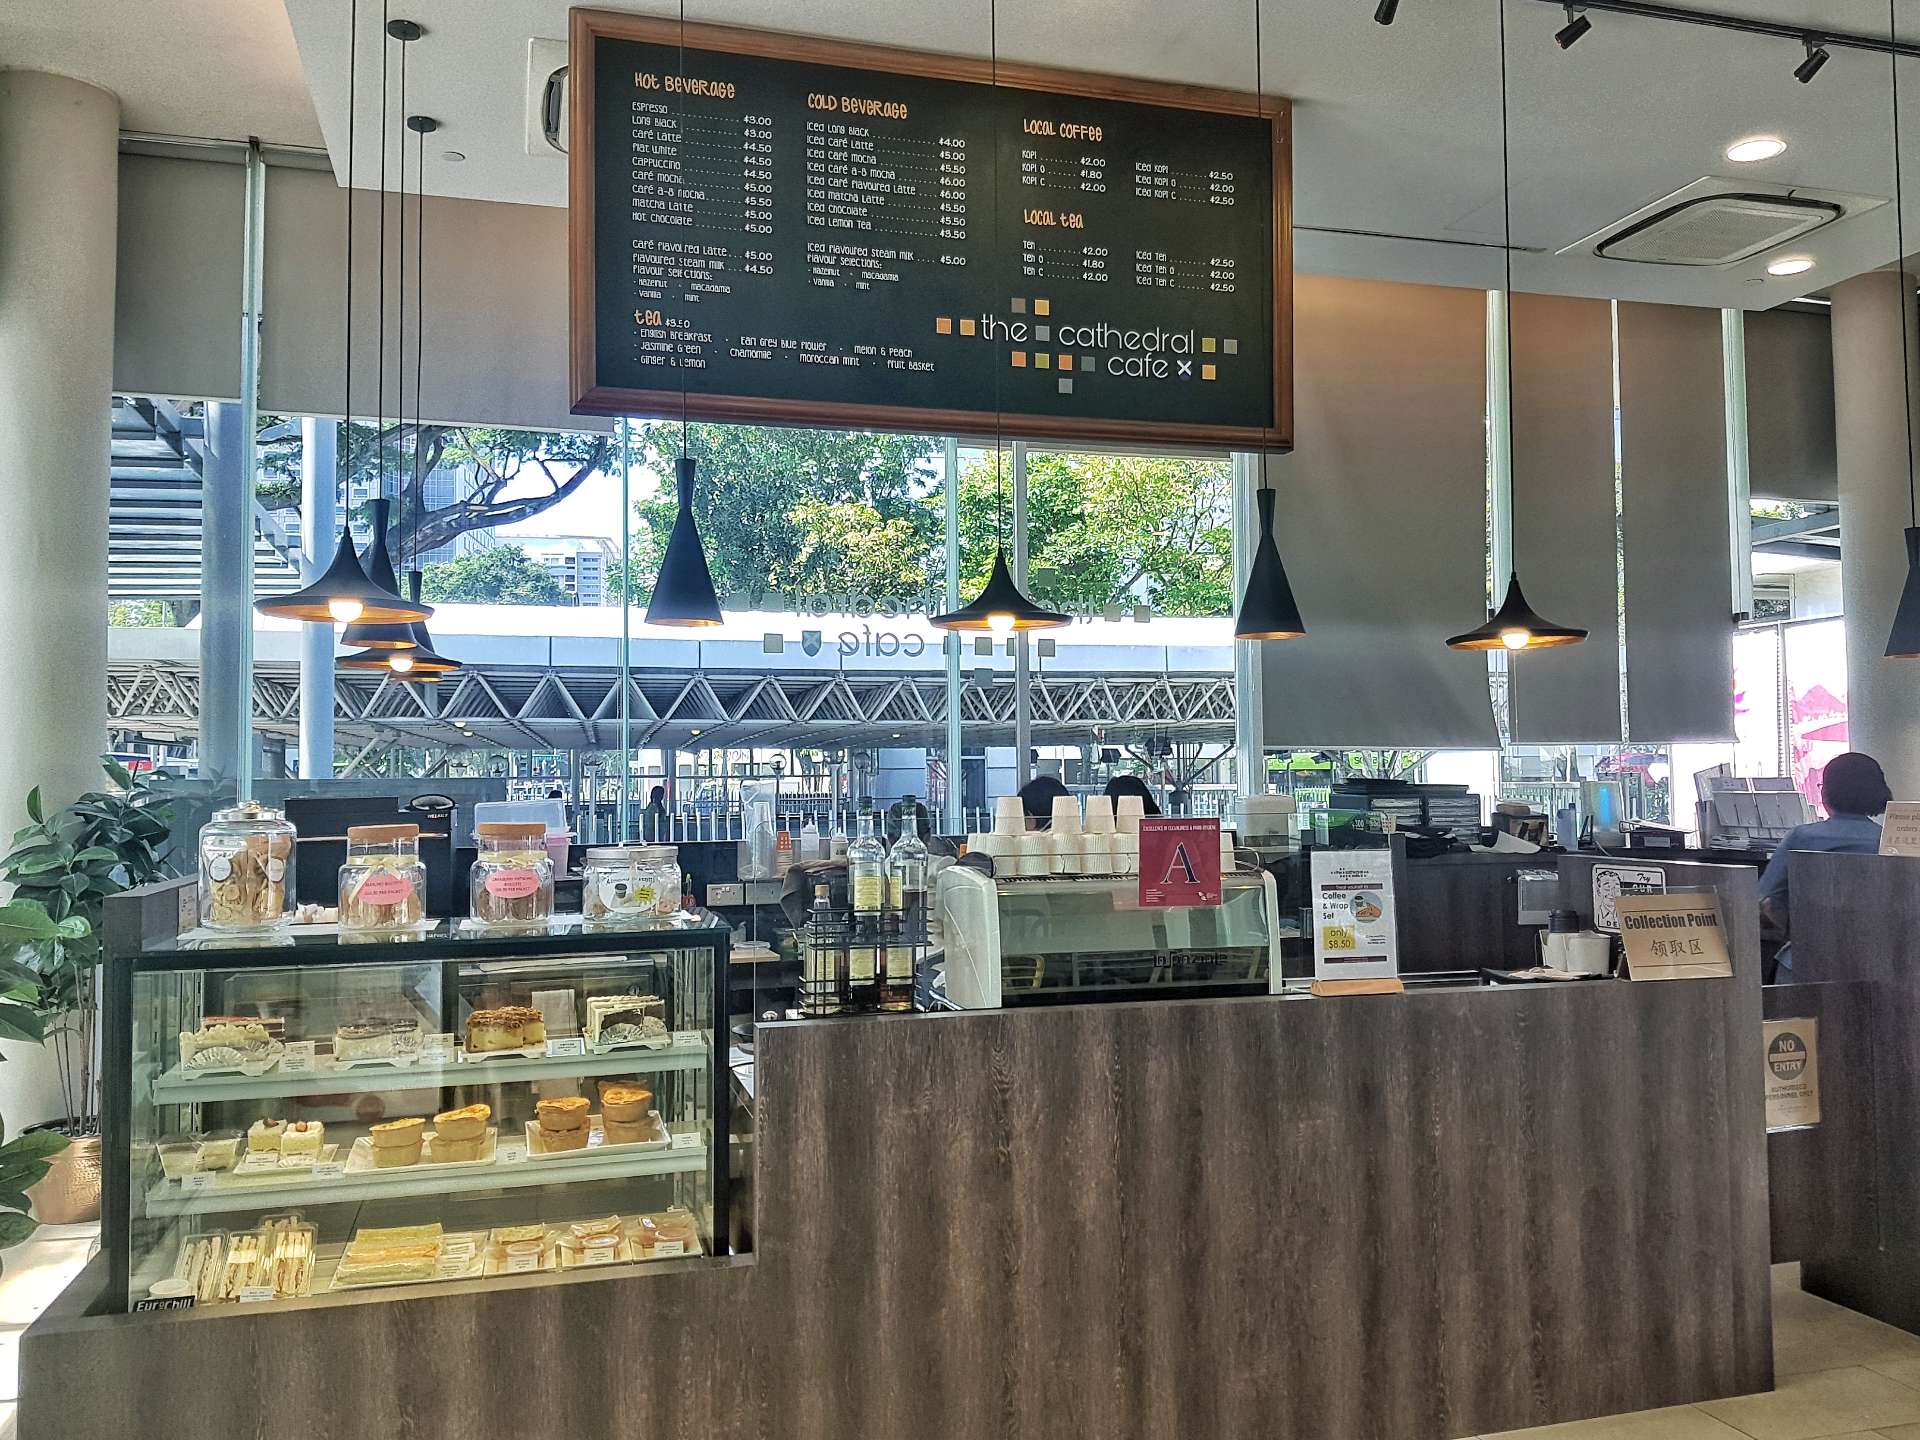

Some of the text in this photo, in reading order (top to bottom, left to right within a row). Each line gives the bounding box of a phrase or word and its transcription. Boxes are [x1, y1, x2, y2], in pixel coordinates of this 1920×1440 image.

[743, 115, 772, 126] $3.00
[744, 128, 772, 139] $3.00
[743, 142, 772, 153] $4.50
[939, 138, 965, 148] $4.00
[743, 155, 772, 166] $4.50
[939, 151, 965, 161] $5.00
[1080, 157, 1106, 167] $2.00
[940, 164, 965, 174] $5.50
[743, 169, 772, 180] $4.50
[1080, 170, 1102, 180] $1.80
[1209, 171, 1233, 180] $2.50
[940, 177, 965, 187] $6.00
[744, 182, 772, 193] $5.00
[1080, 183, 1106, 192] $2.00
[1210, 184, 1234, 193] $2.00
[940, 190, 965, 200] $6.00
[744, 196, 772, 207] $5.50
[1210, 196, 1234, 206] $2.50
[940, 203, 965, 213] $5.50
[744, 210, 772, 220] $5.00
[940, 216, 965, 226] $5.50
[744, 223, 772, 234] $5.00
[745, 251, 772, 260] $5.00
[1082, 247, 1108, 256] $2.00
[940, 256, 966, 265] $5.00
[1082, 260, 1104, 269] $1.80
[1210, 258, 1234, 268] $2.50
[745, 264, 773, 274] $4.50
[1082, 272, 1108, 282] $2.00
[1210, 271, 1234, 280] $2.00
[1210, 283, 1234, 293] $2.50
[981, 314, 1195, 355] the cathedral
[1108, 353, 1169, 378] cafe
[1160, 842, 1200, 884] A
[1322, 892, 1346, 900] Coffee
[1330, 902, 1348, 911] Wrap
[1625, 915, 1686, 929] Collection
[1688, 914, 1717, 927] Point
[1330, 928, 1348, 938] only
[1328, 940, 1350, 948] $8.50
[1651, 939, 1704, 957] 领取区
[1779, 1040, 1794, 1052] NO
[1774, 1062, 1801, 1072] ENTRY
